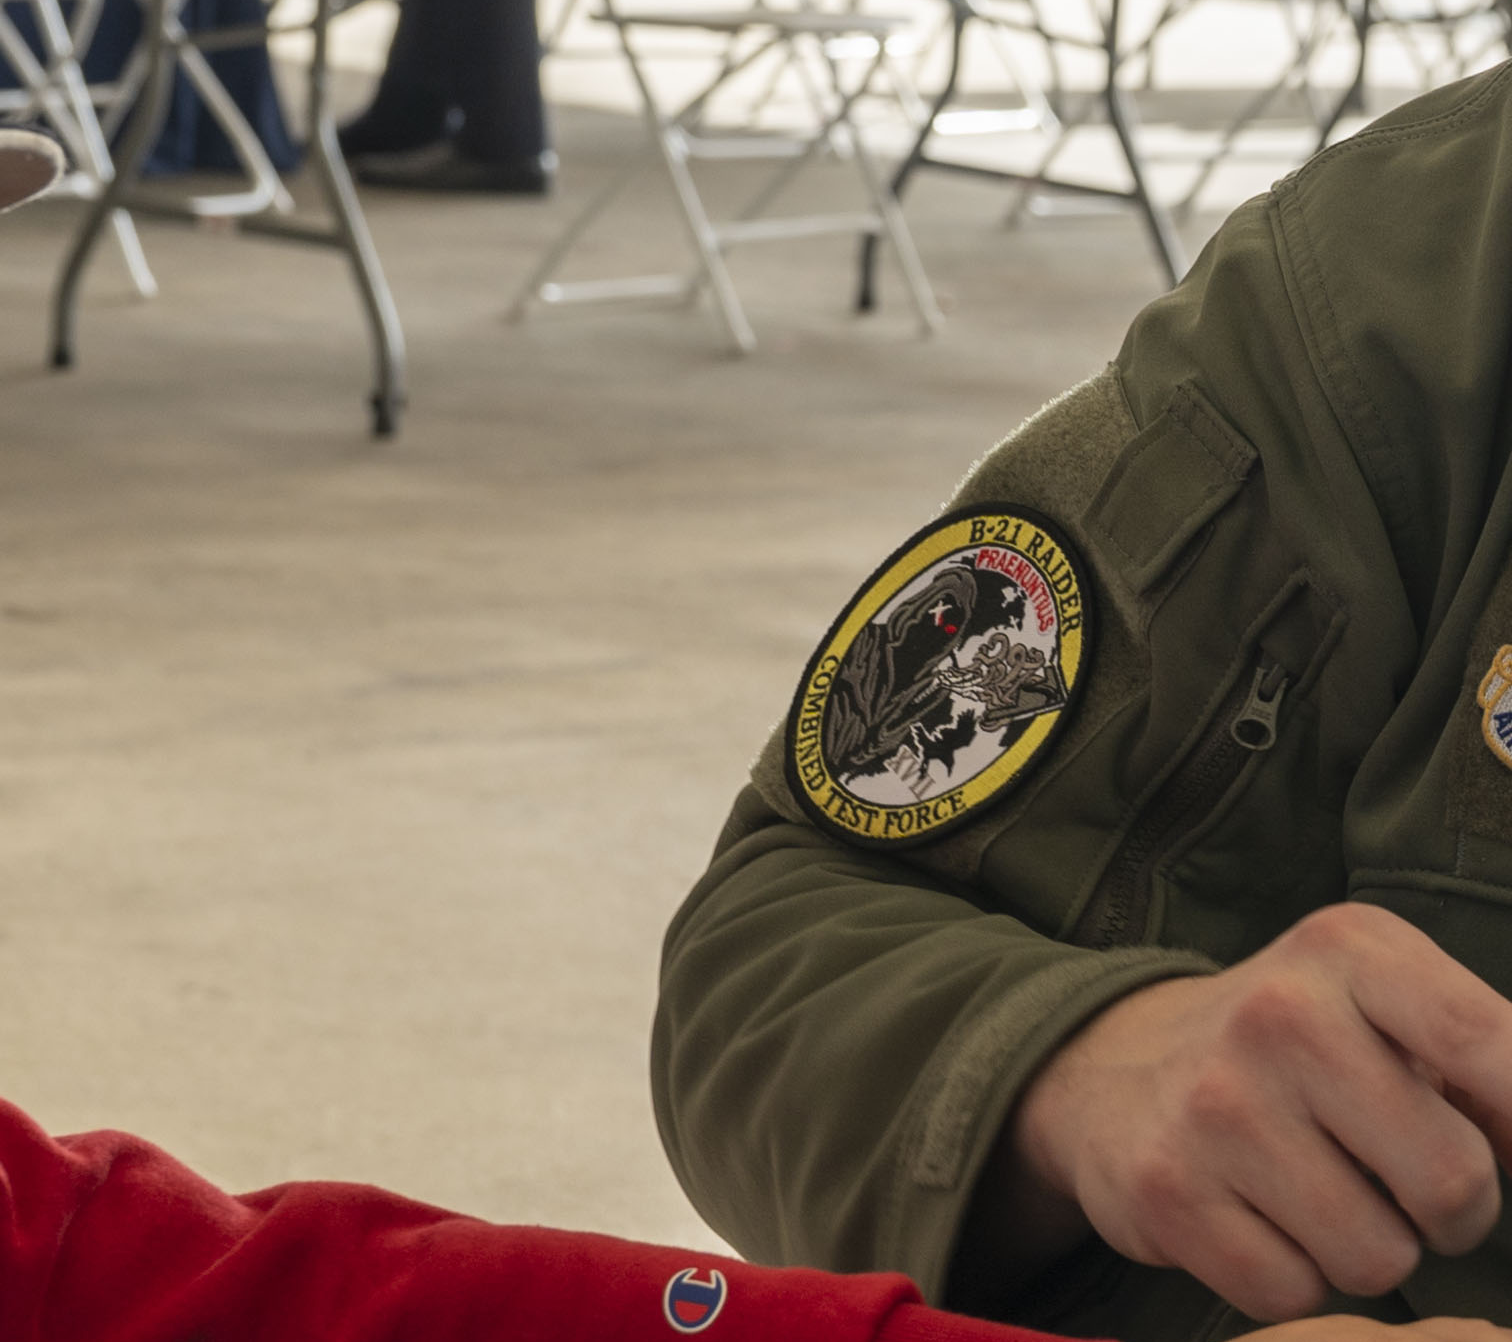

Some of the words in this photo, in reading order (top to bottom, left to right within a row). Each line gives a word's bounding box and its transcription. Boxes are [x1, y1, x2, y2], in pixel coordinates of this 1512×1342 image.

[969, 518, 1024, 547] B-21
[1026, 530, 1083, 637] RAIDER
[795, 654, 840, 792] COMBINED
[822, 784, 879, 834] TEST
[883, 790, 967, 834] FORCE
